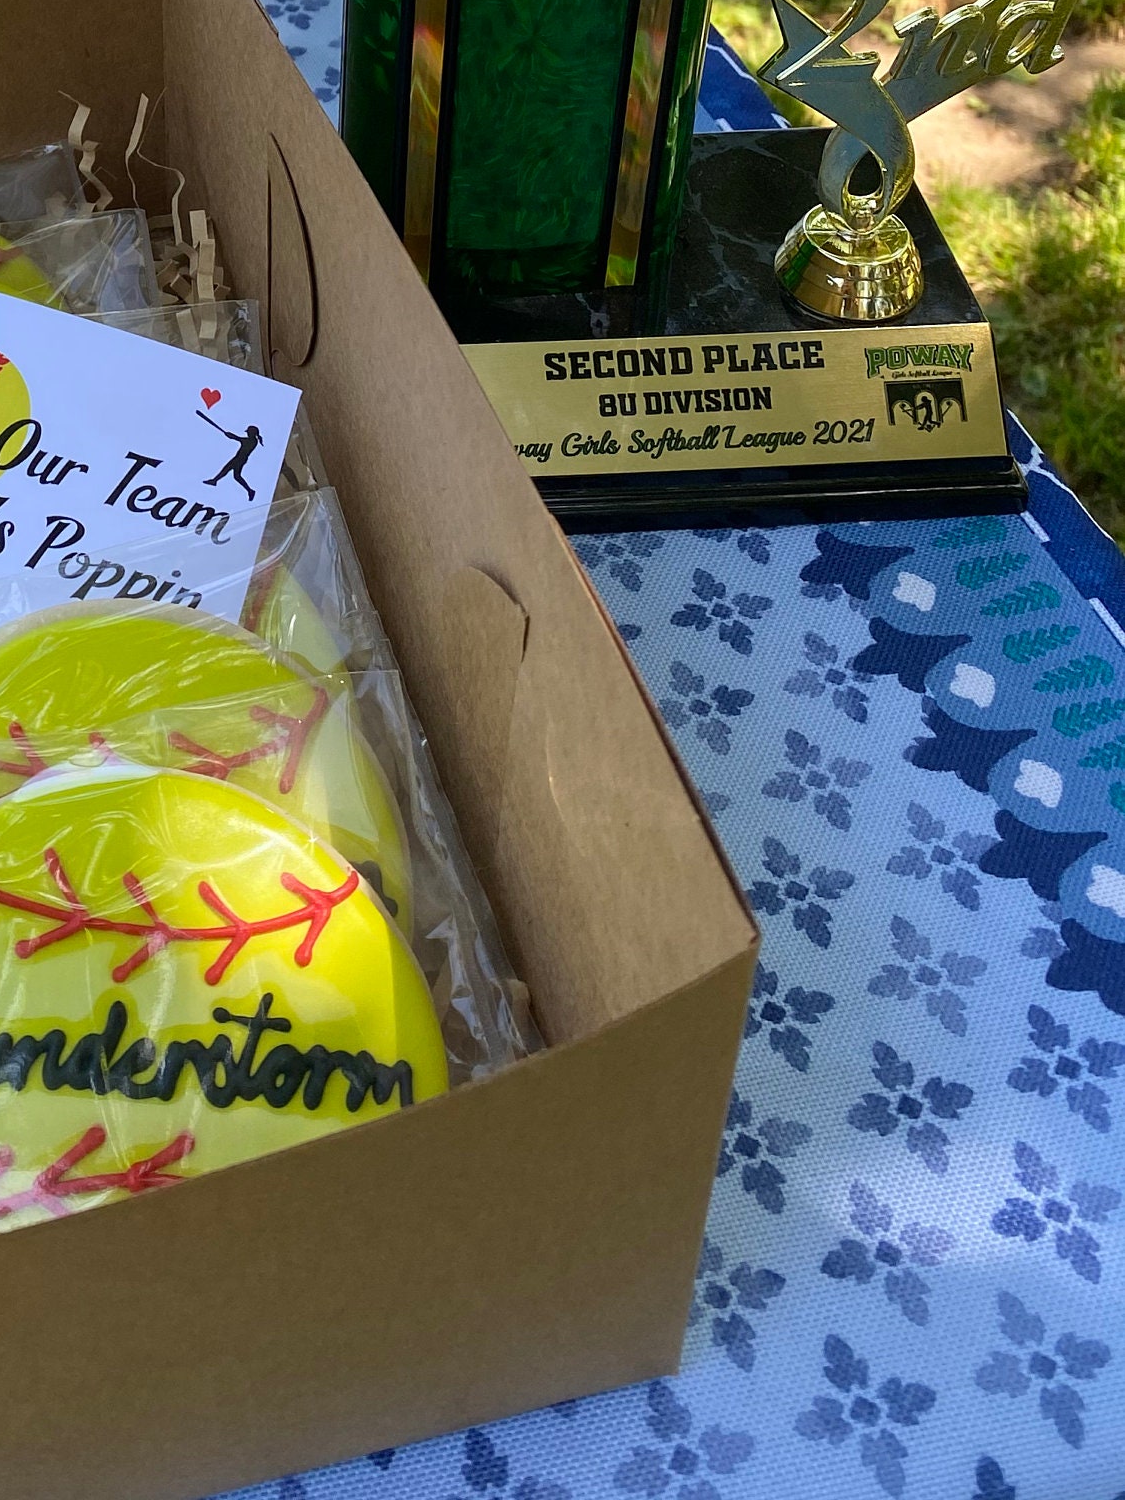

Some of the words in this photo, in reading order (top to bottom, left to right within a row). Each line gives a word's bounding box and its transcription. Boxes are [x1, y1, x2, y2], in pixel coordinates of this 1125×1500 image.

[544, 346, 694, 382] SECOND
[704, 340, 826, 375] PLACE
[864, 343, 975, 379] POWAY
[598, 390, 638, 418] 8U
[644, 386, 773, 416] DIVISION
[560, 429, 622, 458] Girls
[626, 424, 720, 460] Softball
[721, 428, 807, 454] League
[812, 417, 876, 446] 2021
[104, 451, 232, 546] Team
